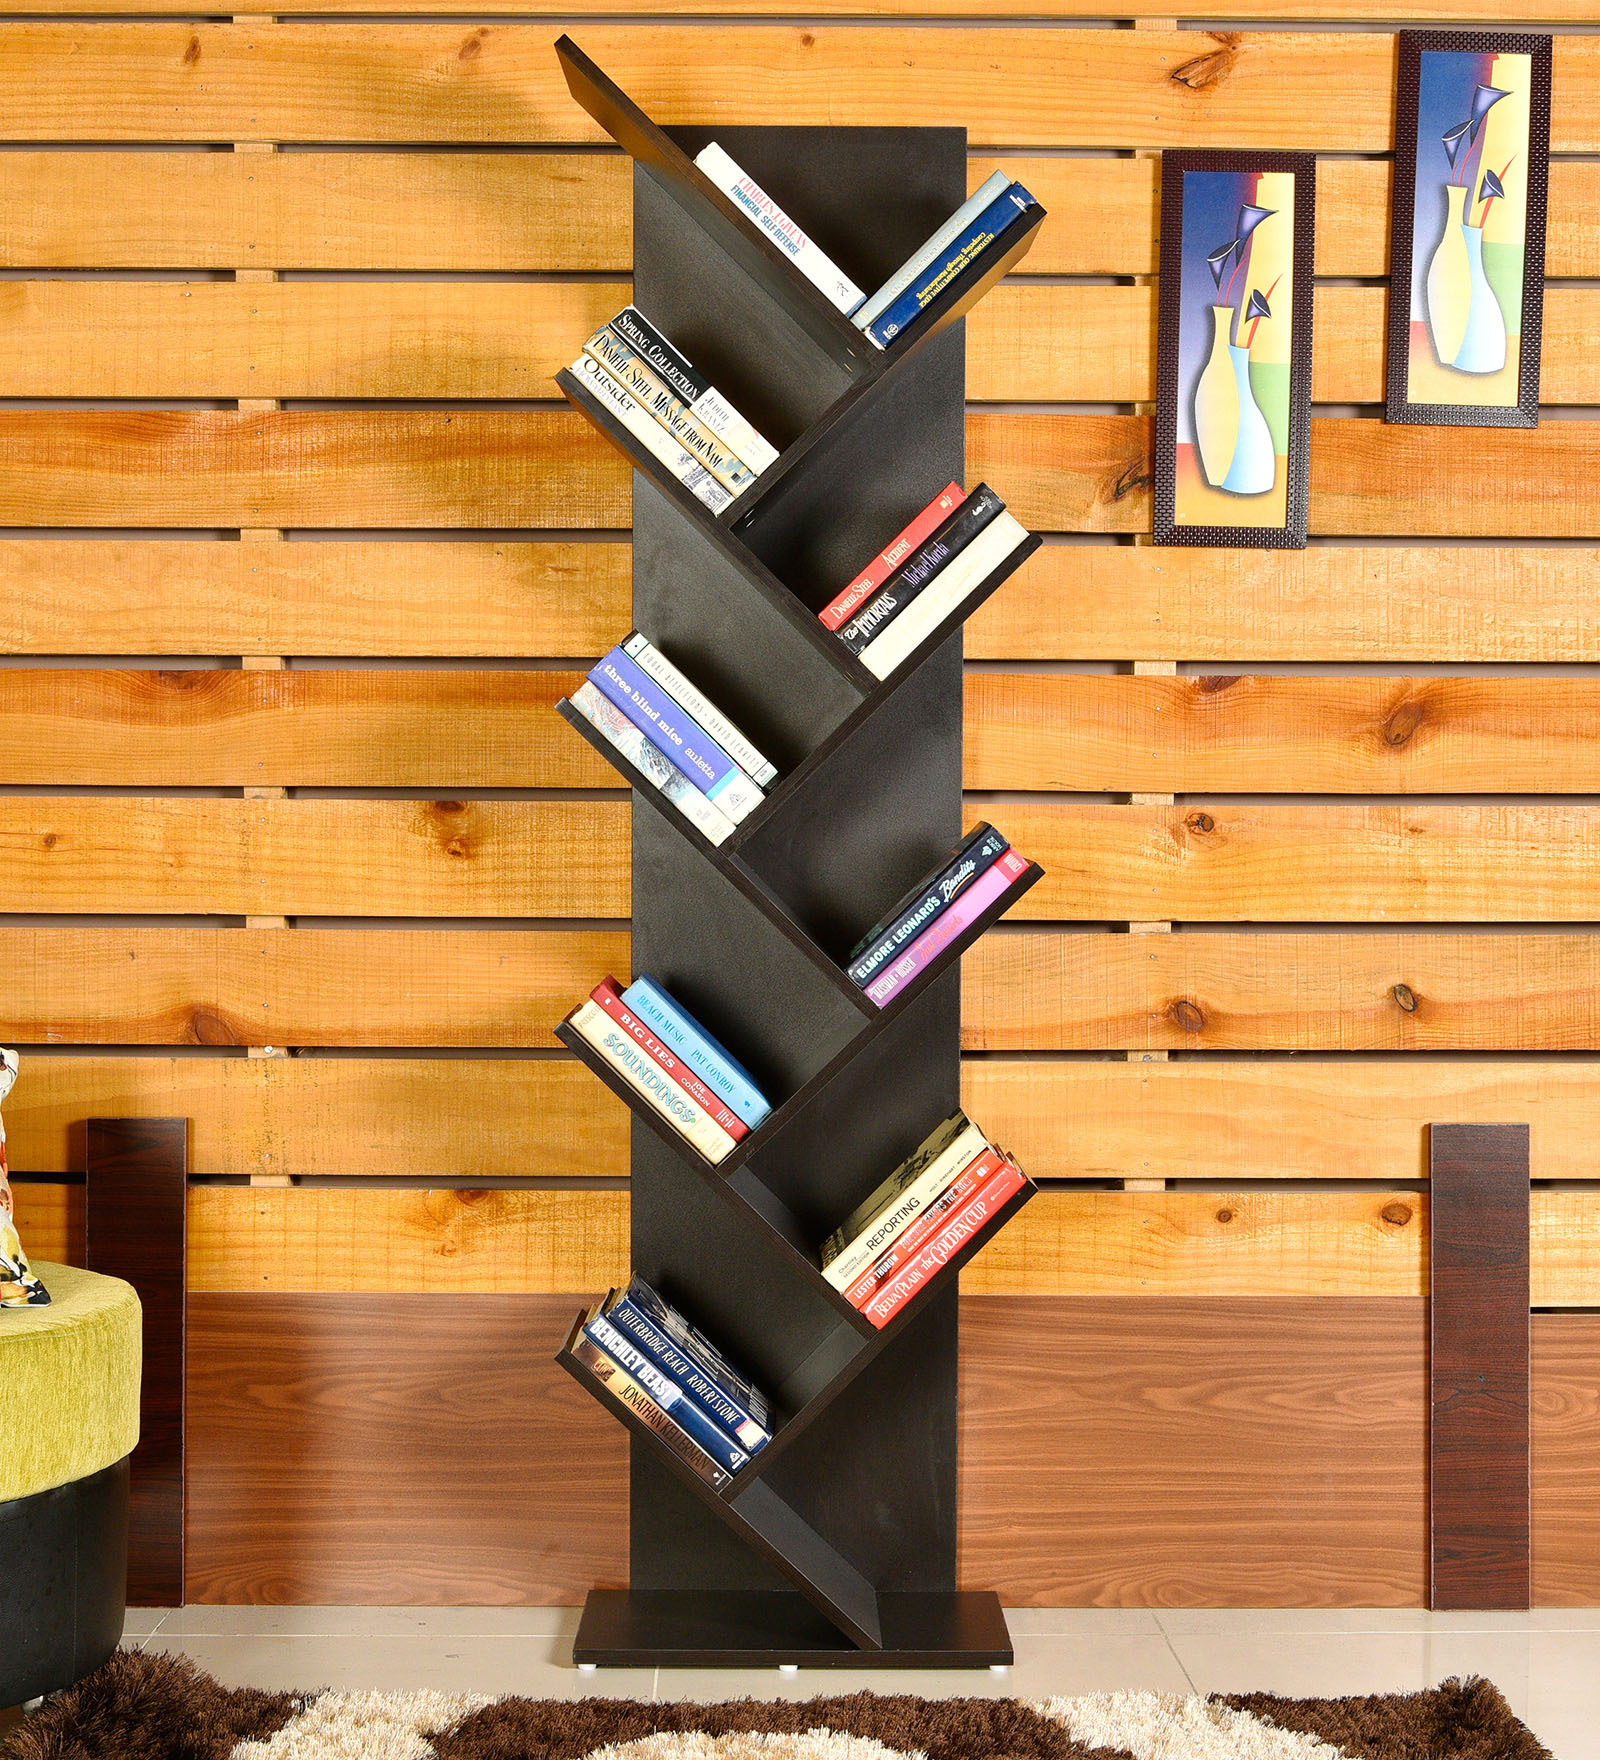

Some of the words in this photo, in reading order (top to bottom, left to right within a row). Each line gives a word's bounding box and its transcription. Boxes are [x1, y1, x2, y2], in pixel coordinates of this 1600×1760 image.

[731, 184, 762, 218] FINANCIAL
[738, 177, 774, 214] CHARLES
[584, 359, 635, 415] Outsider
[618, 315, 649, 349] SPRING
[649, 345, 700, 399] COLLECTION
[592, 334, 631, 380] DANIELLE
[627, 368, 651, 399] STEEL
[650, 391, 688, 432] MESSAGE
[682, 426, 707, 453] FROM
[700, 443, 723, 468] NAM
[830, 592, 858, 620] DANIELLE
[852, 578, 874, 598] STEEL
[881, 538, 911, 570] ACCIDENT
[844, 626, 859, 639] The
[853, 592, 897, 637] IMMORTALS
[901, 549, 933, 588] Michael
[925, 541, 950, 570] Korda
[603, 664, 632, 694] three
[631, 688, 661, 722] blind
[658, 719, 683, 746] mice
[685, 748, 716, 781] auletta
[856, 940, 895, 979] ELMORE
[892, 895, 941, 944] LEONARD'S
[939, 859, 976, 902] Bandits
[603, 1032, 696, 1123] SOUNDINGS
[620, 1013, 645, 1038] BIG
[645, 1037, 675, 1069] LIES
[638, 994, 667, 1024] BEACH
[661, 1018, 688, 1045] MUSIC
[691, 1049, 707, 1067] PAT
[705, 1063, 737, 1094] CONROY
[681, 1078, 711, 1106] CONASON
[693, 1081, 706, 1094] JOE
[866, 1197, 921, 1251] REPORTING
[874, 1291, 902, 1318] BELVA
[896, 1268, 925, 1298] PLAIN
[920, 1256, 935, 1271] the
[929, 1220, 974, 1265] GOLDEN
[968, 1201, 988, 1226] CUP
[854, 1277, 877, 1299] LESTER
[874, 1254, 899, 1280] THUROW
[590, 1319, 645, 1371] BENCHLEY
[636, 1363, 672, 1401] BEAST
[618, 1308, 668, 1354] OUTERBRIDGE
[661, 1350, 690, 1376] REACH
[687, 1374, 715, 1404] ROBERT
[712, 1399, 740, 1425] STONE
[619, 1384, 664, 1428] JONATHAN
[659, 1416, 709, 1471] KELLERMAN
